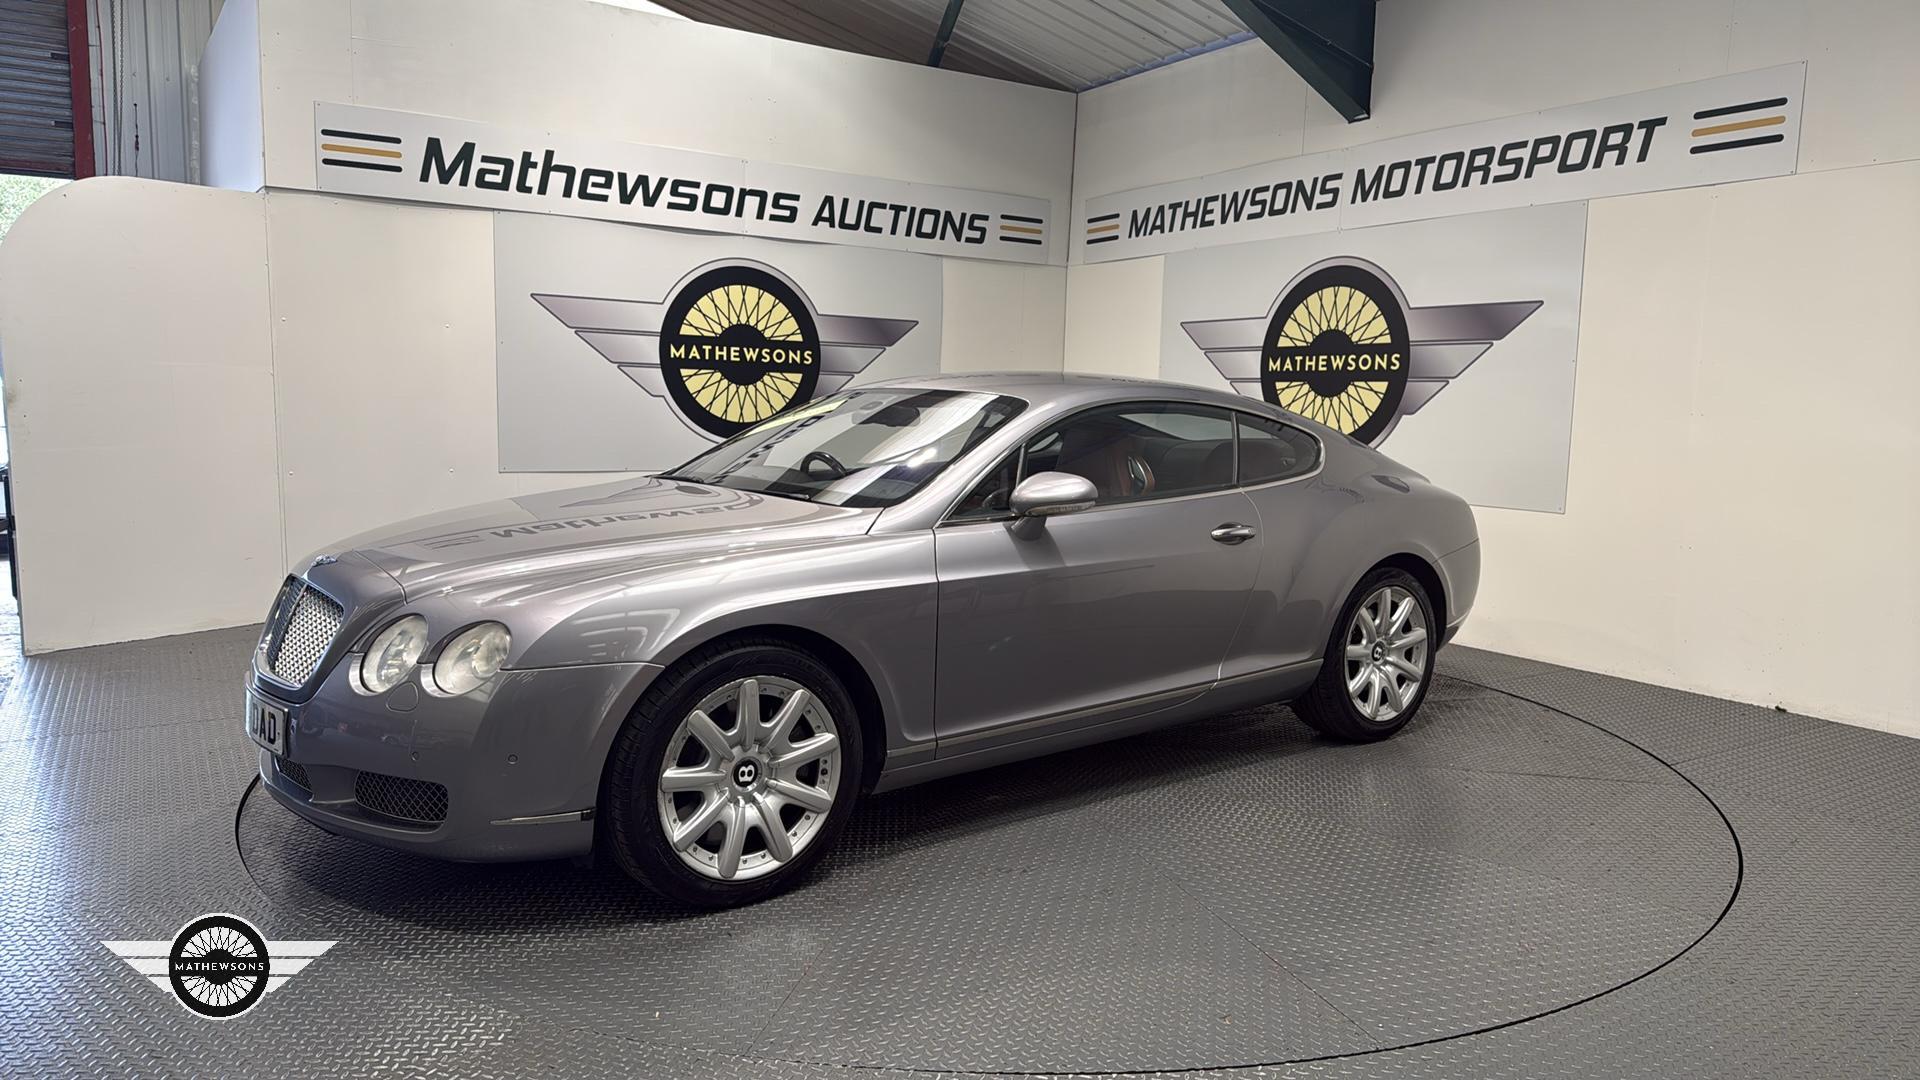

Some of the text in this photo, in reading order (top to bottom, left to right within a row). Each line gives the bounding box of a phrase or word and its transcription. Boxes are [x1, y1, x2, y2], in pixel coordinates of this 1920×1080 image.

[419, 136, 990, 245] Mathewsons AUCTIONS
[1128, 116, 1669, 239] MATHEWSONS MOTORSPORT
[669, 343, 814, 367] MATHEWSONS
[1267, 353, 1402, 373] MATHEWSONS
